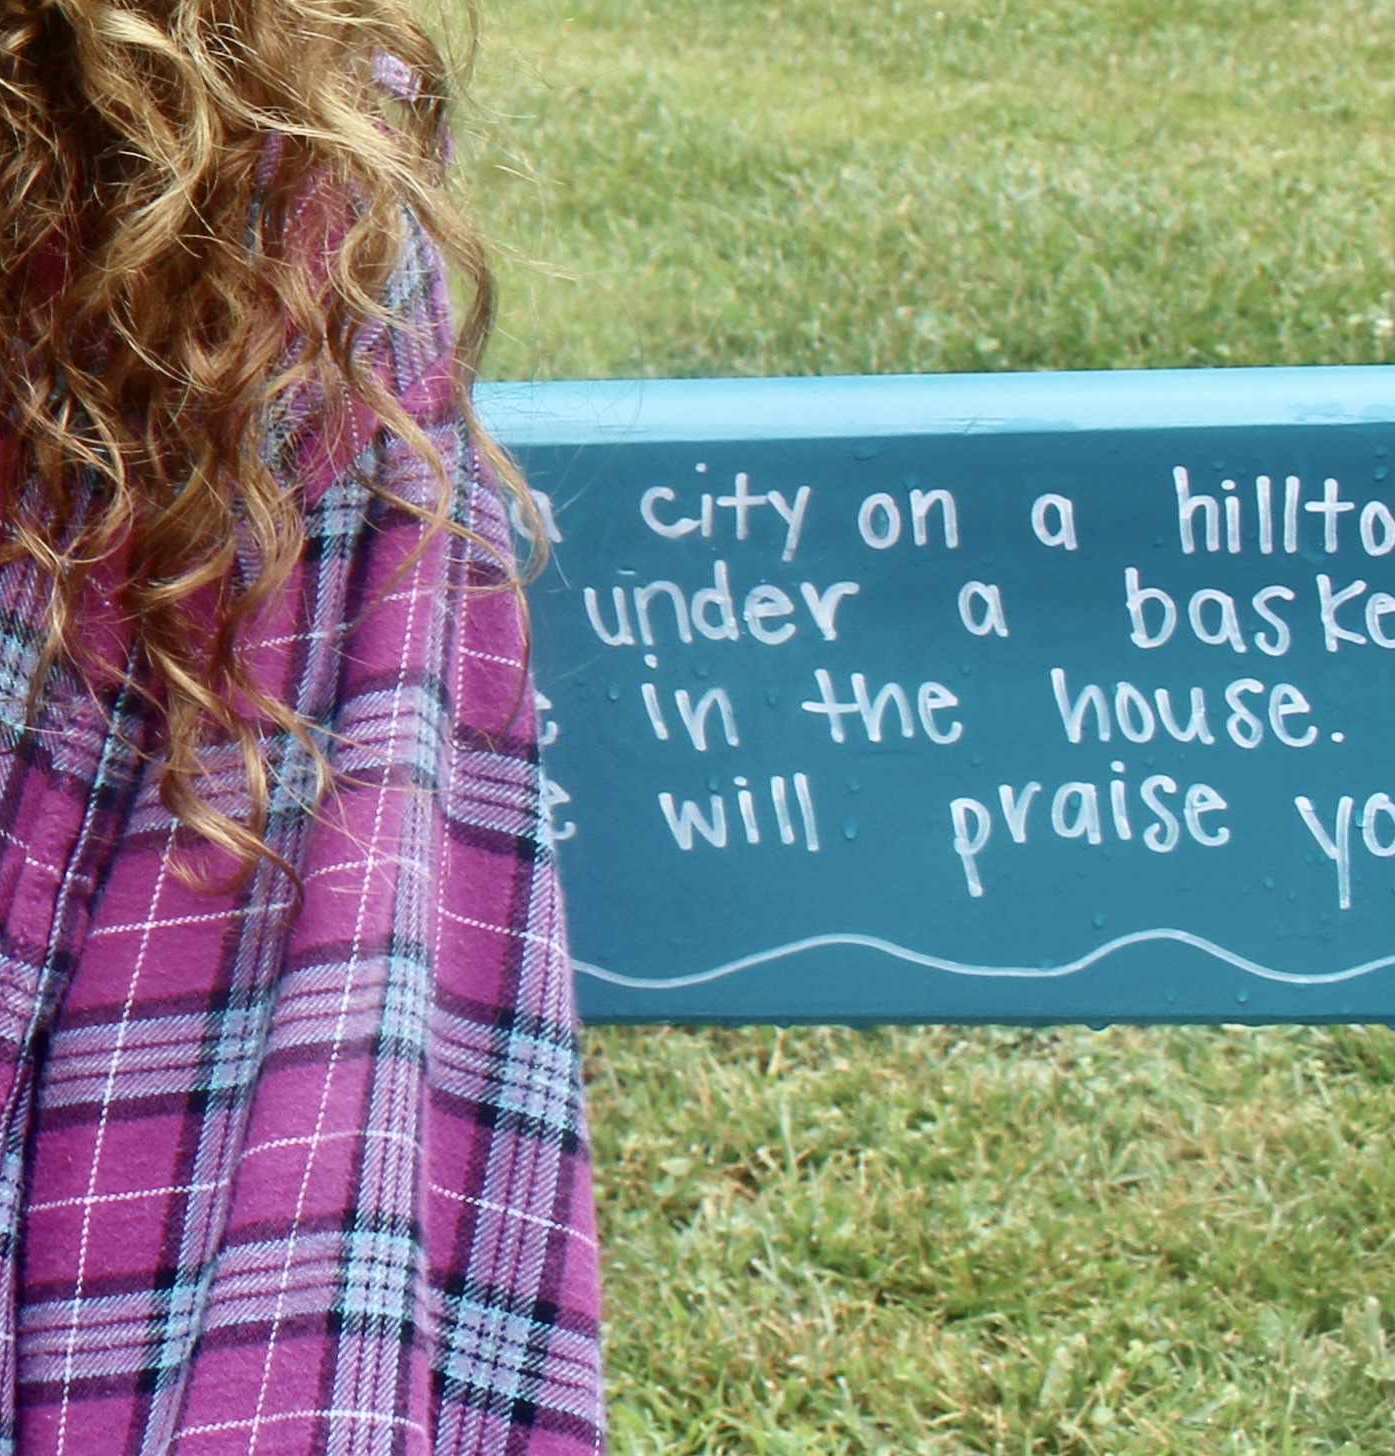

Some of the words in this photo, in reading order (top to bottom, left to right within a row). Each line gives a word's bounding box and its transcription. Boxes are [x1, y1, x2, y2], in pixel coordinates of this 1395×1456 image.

[640, 464, 811, 562] city
[858, 489, 959, 550] on
[1031, 493, 1078, 551] a
[1173, 466, 1395, 556] hillto
[583, 560, 860, 646] under
[958, 581, 1009, 637] a
[641, 654, 740, 752] in
[801, 668, 963, 745] the
[1050, 667, 1346, 750] house.
[658, 773, 820, 852] will
[950, 761, 1231, 898] praise
[1294, 792, 1395, 910] yo
